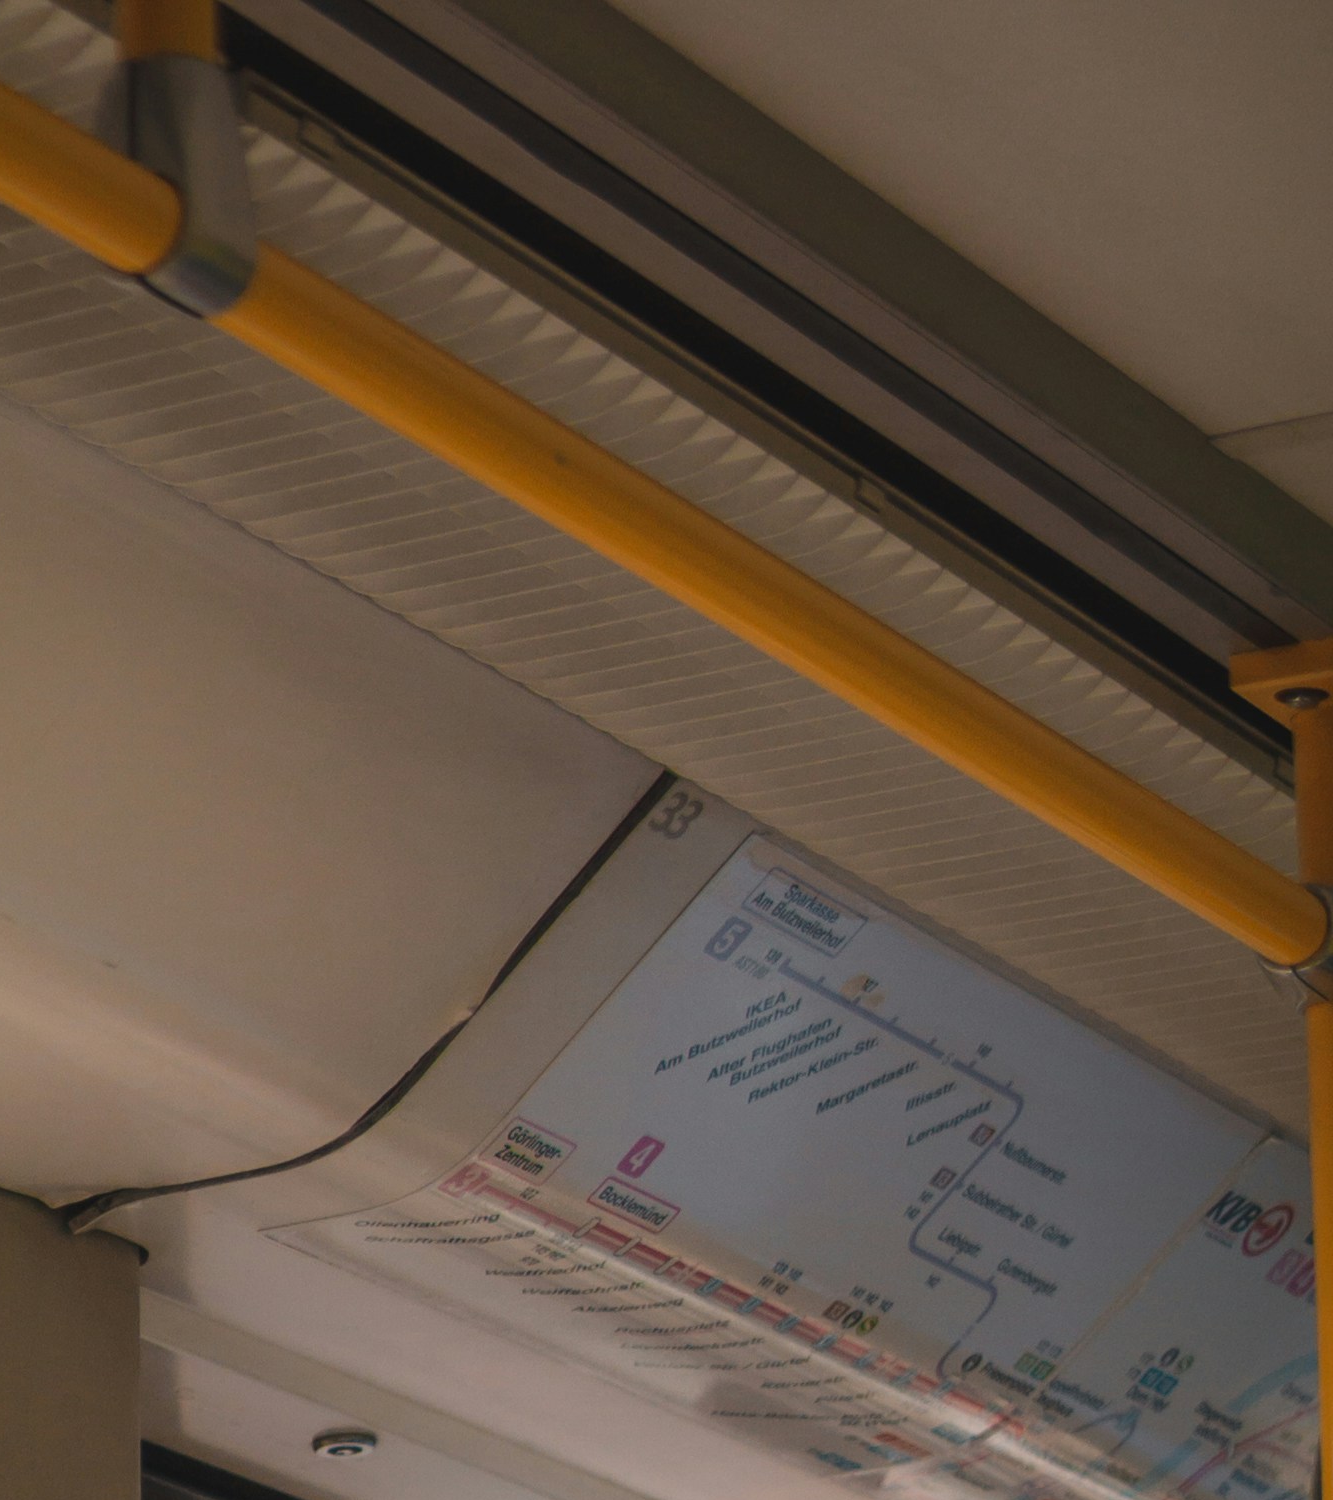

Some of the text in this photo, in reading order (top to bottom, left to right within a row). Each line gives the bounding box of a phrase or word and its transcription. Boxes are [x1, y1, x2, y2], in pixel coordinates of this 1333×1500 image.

[648, 791, 704, 840] 33
[751, 891, 848, 950] Am Butzweilerhof
[783, 883, 840, 924] Sparkasse
[745, 989, 788, 1020] IKEA
[653, 997, 803, 1076] Am Butzweilerhof
[705, 1017, 833, 1083] Alter Flughafen
[729, 1025, 843, 1088] Butzweilerhof
[746, 1036, 880, 1106] Rektor-Klein-Str.
[815, 1059, 919, 1116] Margaretastr.
[506, 1125, 562, 1160] Görlinger-
[905, 1099, 994, 1148] Lenauplatz
[494, 1143, 545, 1176] Zentrum
[598, 1184, 670, 1227] Bocklemünd
[1205, 1190, 1263, 1234] KVB
